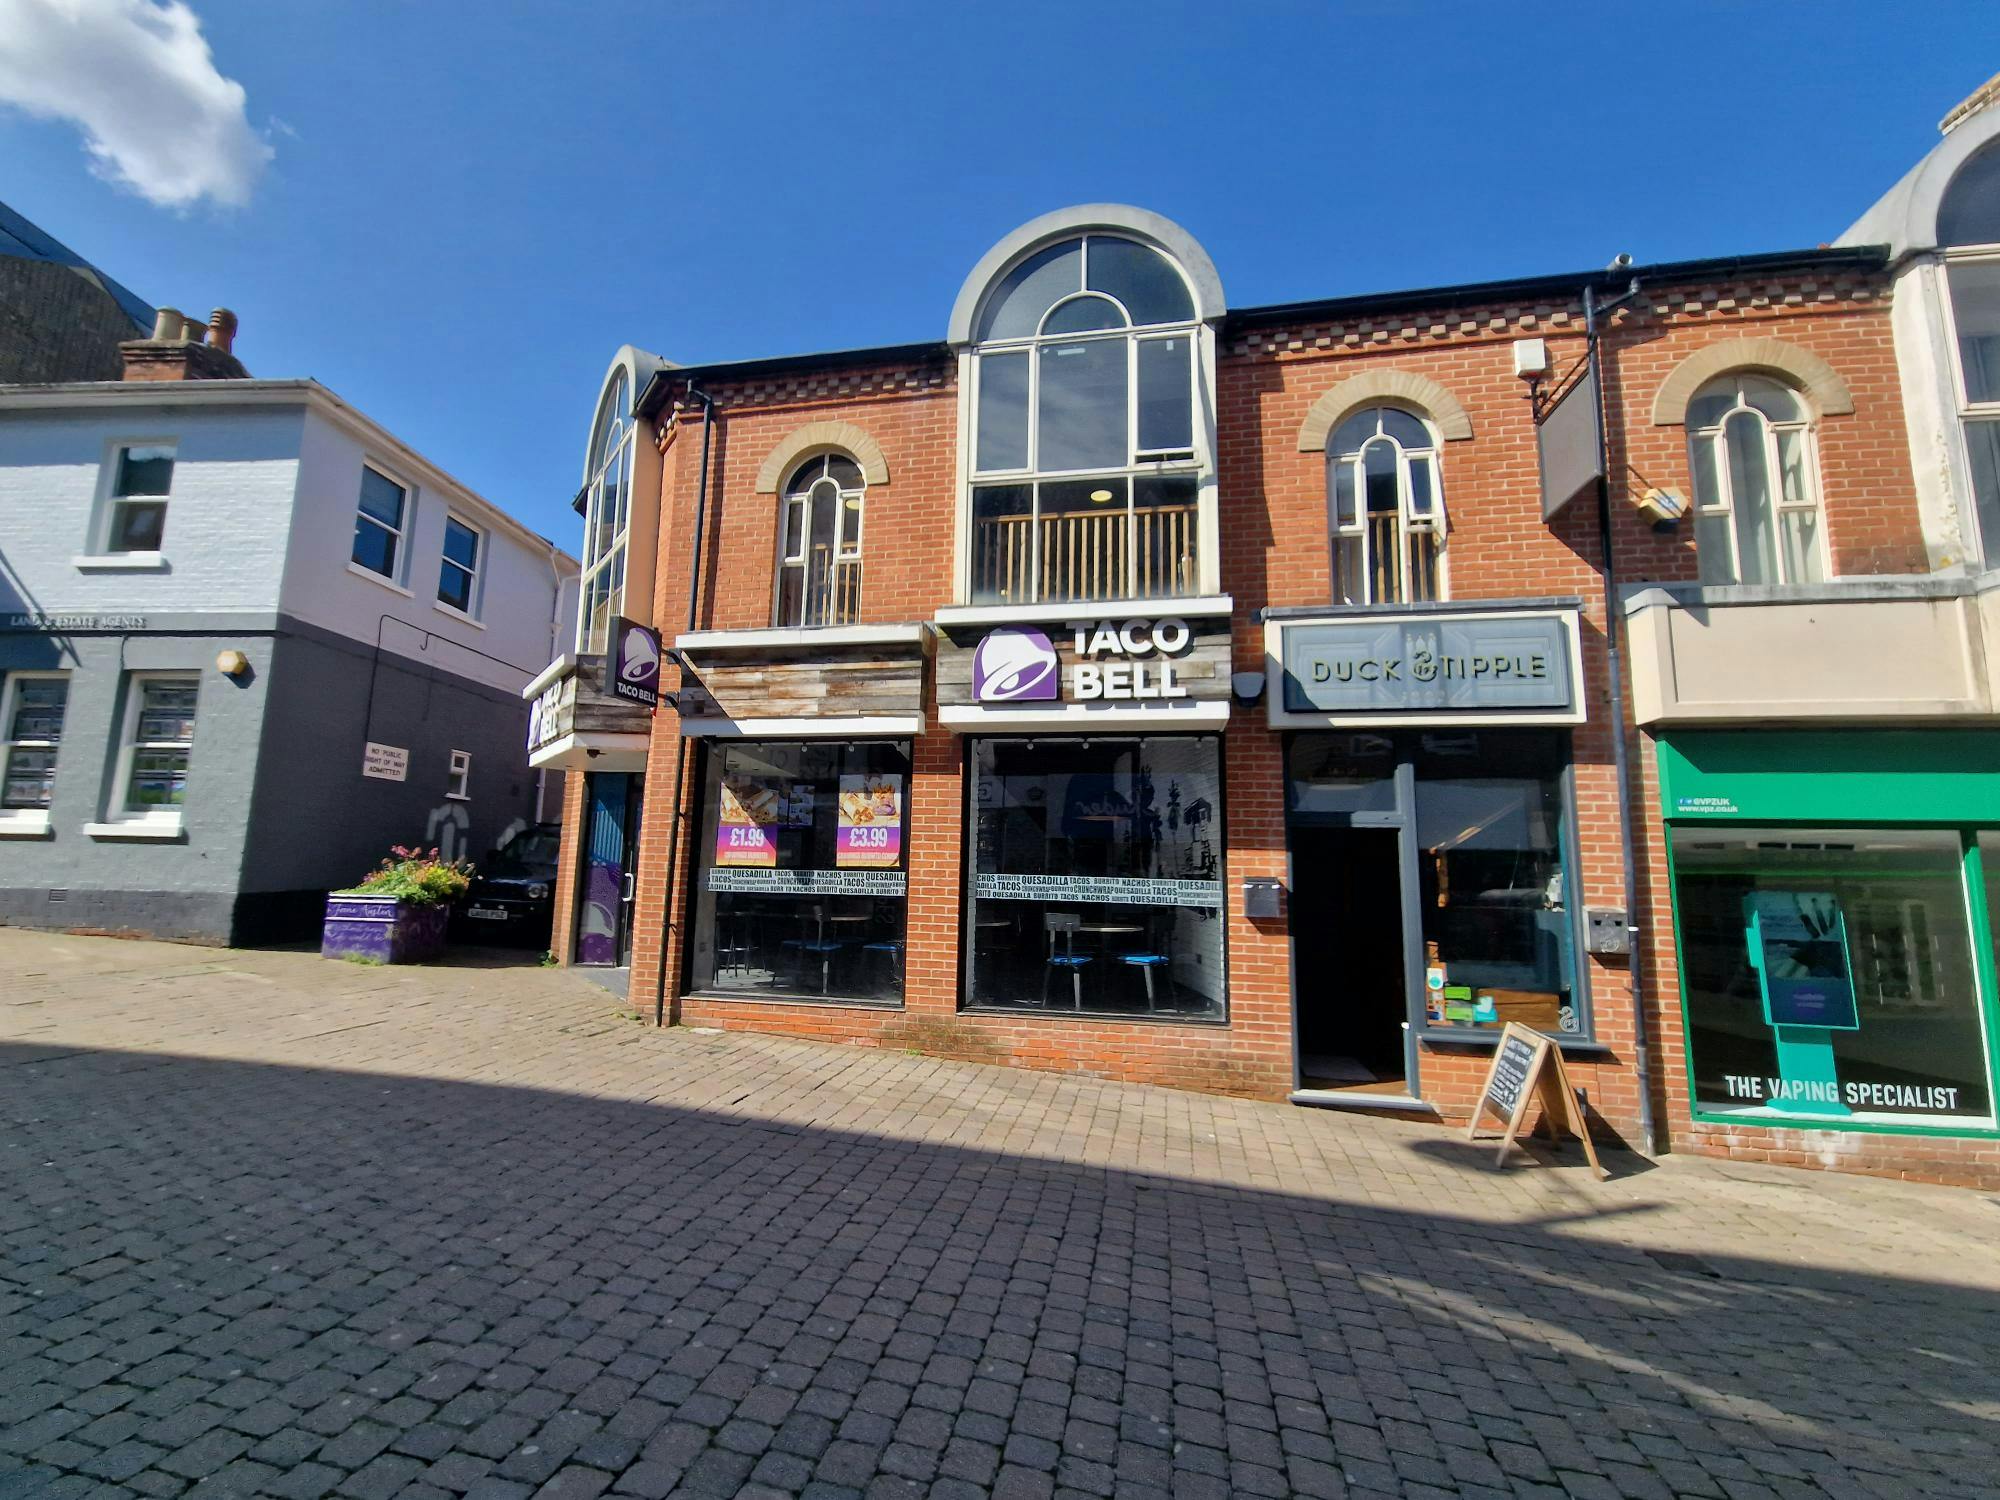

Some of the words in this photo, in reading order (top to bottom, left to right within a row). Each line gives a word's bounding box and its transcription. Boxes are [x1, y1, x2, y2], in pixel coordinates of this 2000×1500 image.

[56, 615, 94, 627] ESTATE
[101, 615, 144, 627] AGENTS
[1065, 616, 1190, 654] TACO
[1311, 658, 1402, 683] DUCK
[1411, 649, 1439, 683] &
[1439, 655, 1547, 681] TIPPLE
[1073, 662, 1187, 699] BELL
[617, 682, 638, 699] TACO
[638, 690, 657, 704] BELL
[366, 755, 381, 764] RIGHT
[382, 750, 402, 759] PUBLIC
[368, 766, 401, 776] ADMITTED
[1678, 805, 1738, 814] www.vpz.co.uk
[730, 827, 765, 847] £1.99
[849, 827, 888, 847] £3.99
[732, 869, 772, 879] QUESADILLA
[816, 871, 842, 879] NACHOS
[711, 875, 732, 884] TACOS
[811, 878, 843, 886] QUESADILLA
[843, 878, 865, 888] TACOS
[1021, 875, 1069, 886] QUESADILLA
[1069, 877, 1091, 885] TACOS
[1121, 879, 1151, 887] NACHOS
[816, 885, 838, 893] BURRITO
[997, 881, 1021, 891] TACOS
[1073, 884, 1114, 894] CRUNCHWRAP
[1114, 886, 1151, 895] QUESADILLA
[1152, 886, 1178, 896] TACOS
[992, 891, 1031, 899] QUESADILLA
[1033, 892, 1059, 900] BURRITO
[1081, 894, 1110, 902] NACHOS
[1130, 895, 1179, 904] QUESADILLA
[1724, 1075, 1763, 1098] THE
[1767, 1077, 1840, 1103] VAPING
[1846, 1082, 1958, 1110] SPECIALIST
